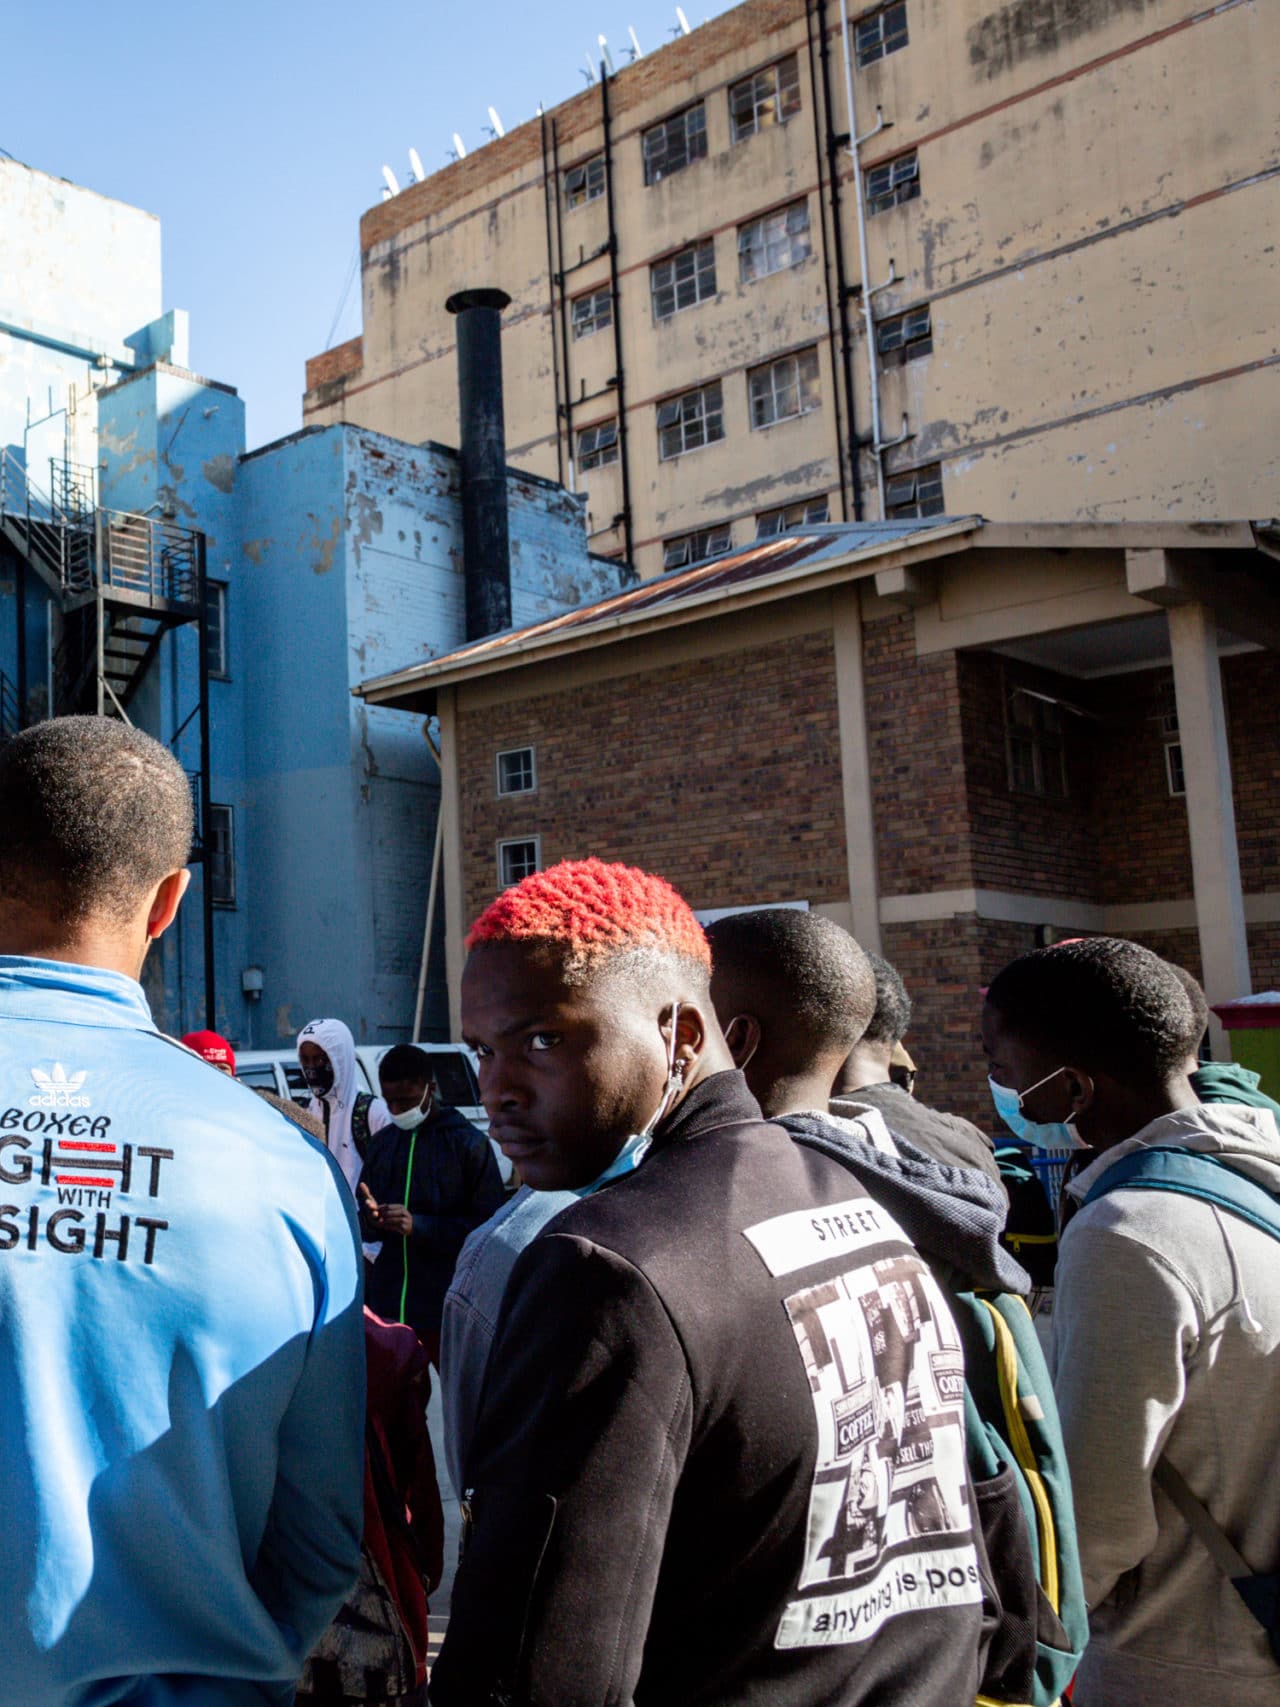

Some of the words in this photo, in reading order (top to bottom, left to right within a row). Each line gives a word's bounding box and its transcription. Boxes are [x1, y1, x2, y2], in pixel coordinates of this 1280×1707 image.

[27, 1093, 91, 1108] adidas
[56, 1187, 112, 1210] WITH
[811, 1209, 882, 1242] STREET
[812, 1583, 894, 1633] anything
[894, 1570, 918, 1596] is
